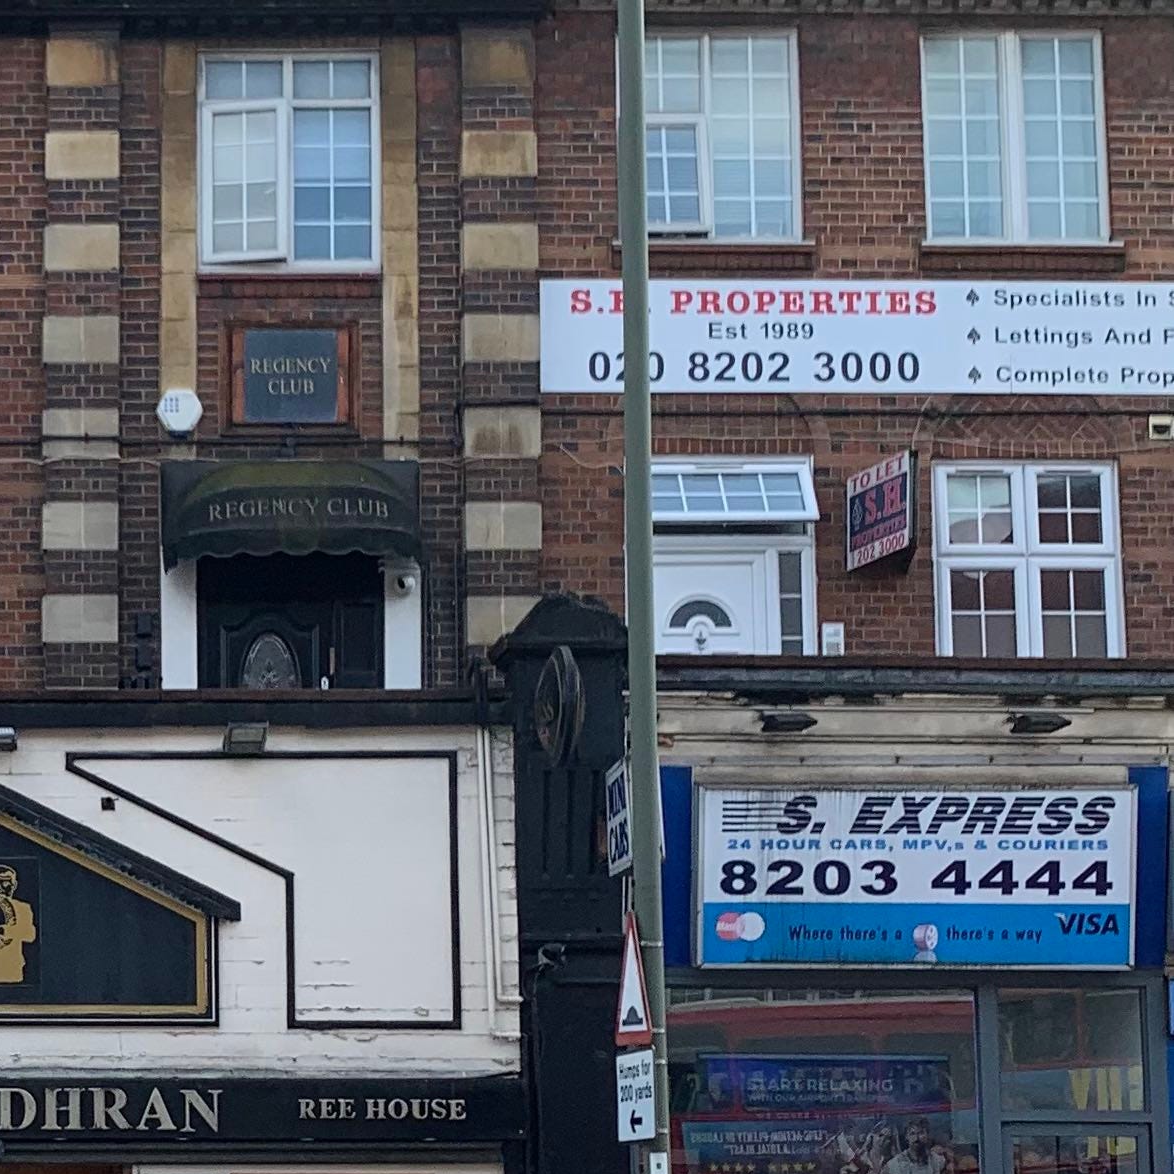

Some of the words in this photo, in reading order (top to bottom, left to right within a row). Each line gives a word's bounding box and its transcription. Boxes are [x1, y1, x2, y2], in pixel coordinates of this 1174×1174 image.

[670, 290, 938, 315] PROPERTIES
[993, 288, 1125, 310] Specialists
[1137, 289, 1157, 307] In
[708, 322, 747, 339] Est
[761, 322, 814, 340] 1989
[994, 327, 1093, 349] Lettings
[1104, 327, 1151, 345] And
[250, 357, 332, 374] REGENCY
[688, 351, 791, 382] 8202
[813, 351, 920, 382] 3000
[996, 365, 1109, 388] Complete
[268, 378, 315, 396] CLUB
[851, 473, 871, 494] TO
[876, 455, 904, 482] LET
[209, 498, 319, 522] REGENCY
[327, 498, 389, 518] CLUB
[857, 545, 876, 565] 202
[879, 533, 905, 557] 3000
[849, 796, 1116, 836] EXPRESS
[727, 839, 752, 850] 24
[760, 839, 821, 850] HOUR
[829, 839, 894, 852] CARS,
[974, 839, 987, 850] &
[997, 839, 1109, 850] COURIERS
[720, 860, 898, 896] 8203
[931, 860, 1114, 896] 4444
[789, 925, 833, 941] Where
[840, 925, 887, 941] there's
[894, 931, 902, 941] a
[946, 925, 994, 941] there's
[1001, 929, 1008, 941] a
[1016, 929, 1043, 944] way
[1054, 912, 1120, 936] VISA
[641, 1059, 651, 1076] for
[620, 1084, 634, 1103] 200
[635, 1081, 653, 1104] yards
[806, 1078, 893, 1092] RELAXING
[298, 1098, 357, 1120] REE
[365, 1098, 467, 1121] HOUSE
